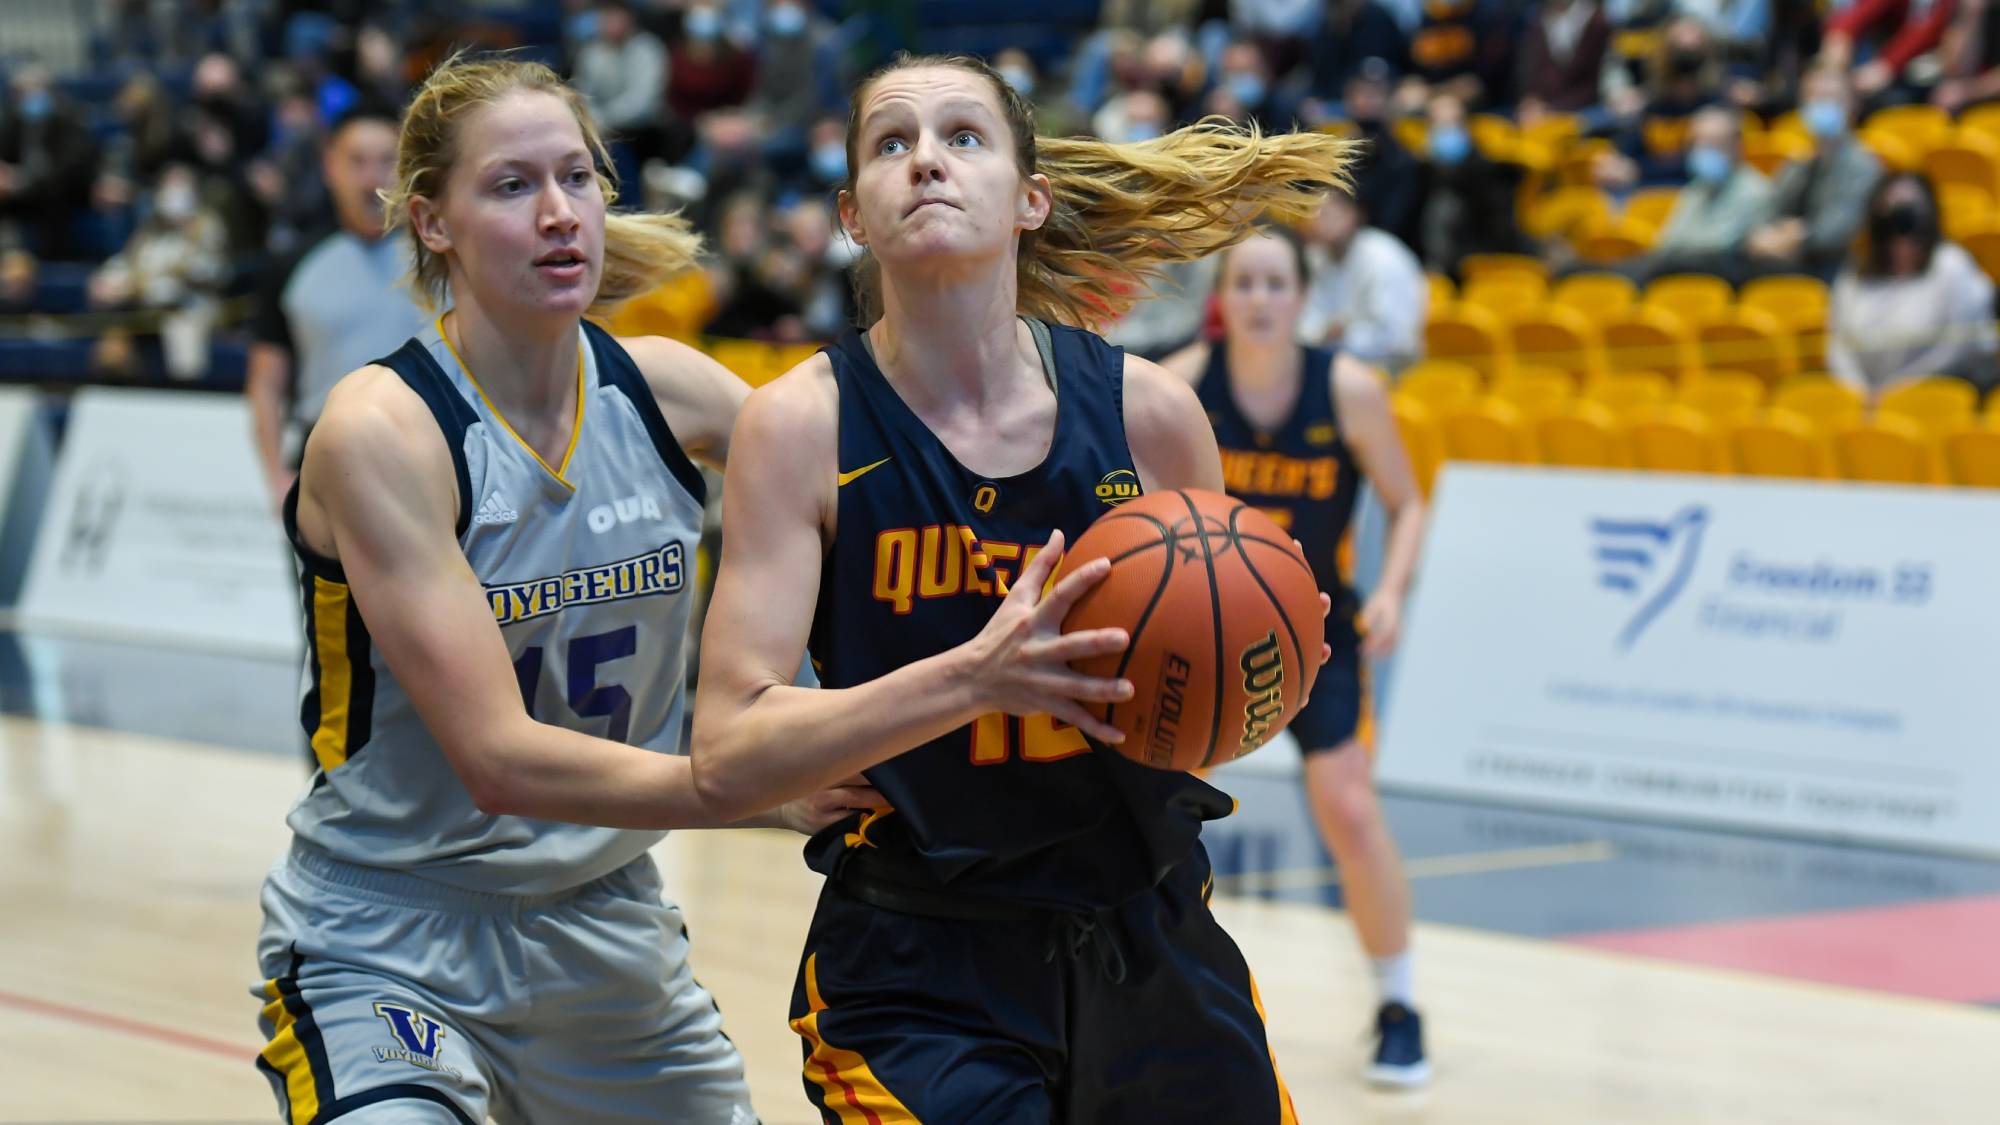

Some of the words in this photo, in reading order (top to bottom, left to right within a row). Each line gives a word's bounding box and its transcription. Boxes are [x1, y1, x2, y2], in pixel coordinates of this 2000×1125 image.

[587, 495, 662, 534] OUA
[974, 486, 997, 513] Q
[474, 510, 519, 524] adidas
[482, 539, 684, 626] OYAGEURS
